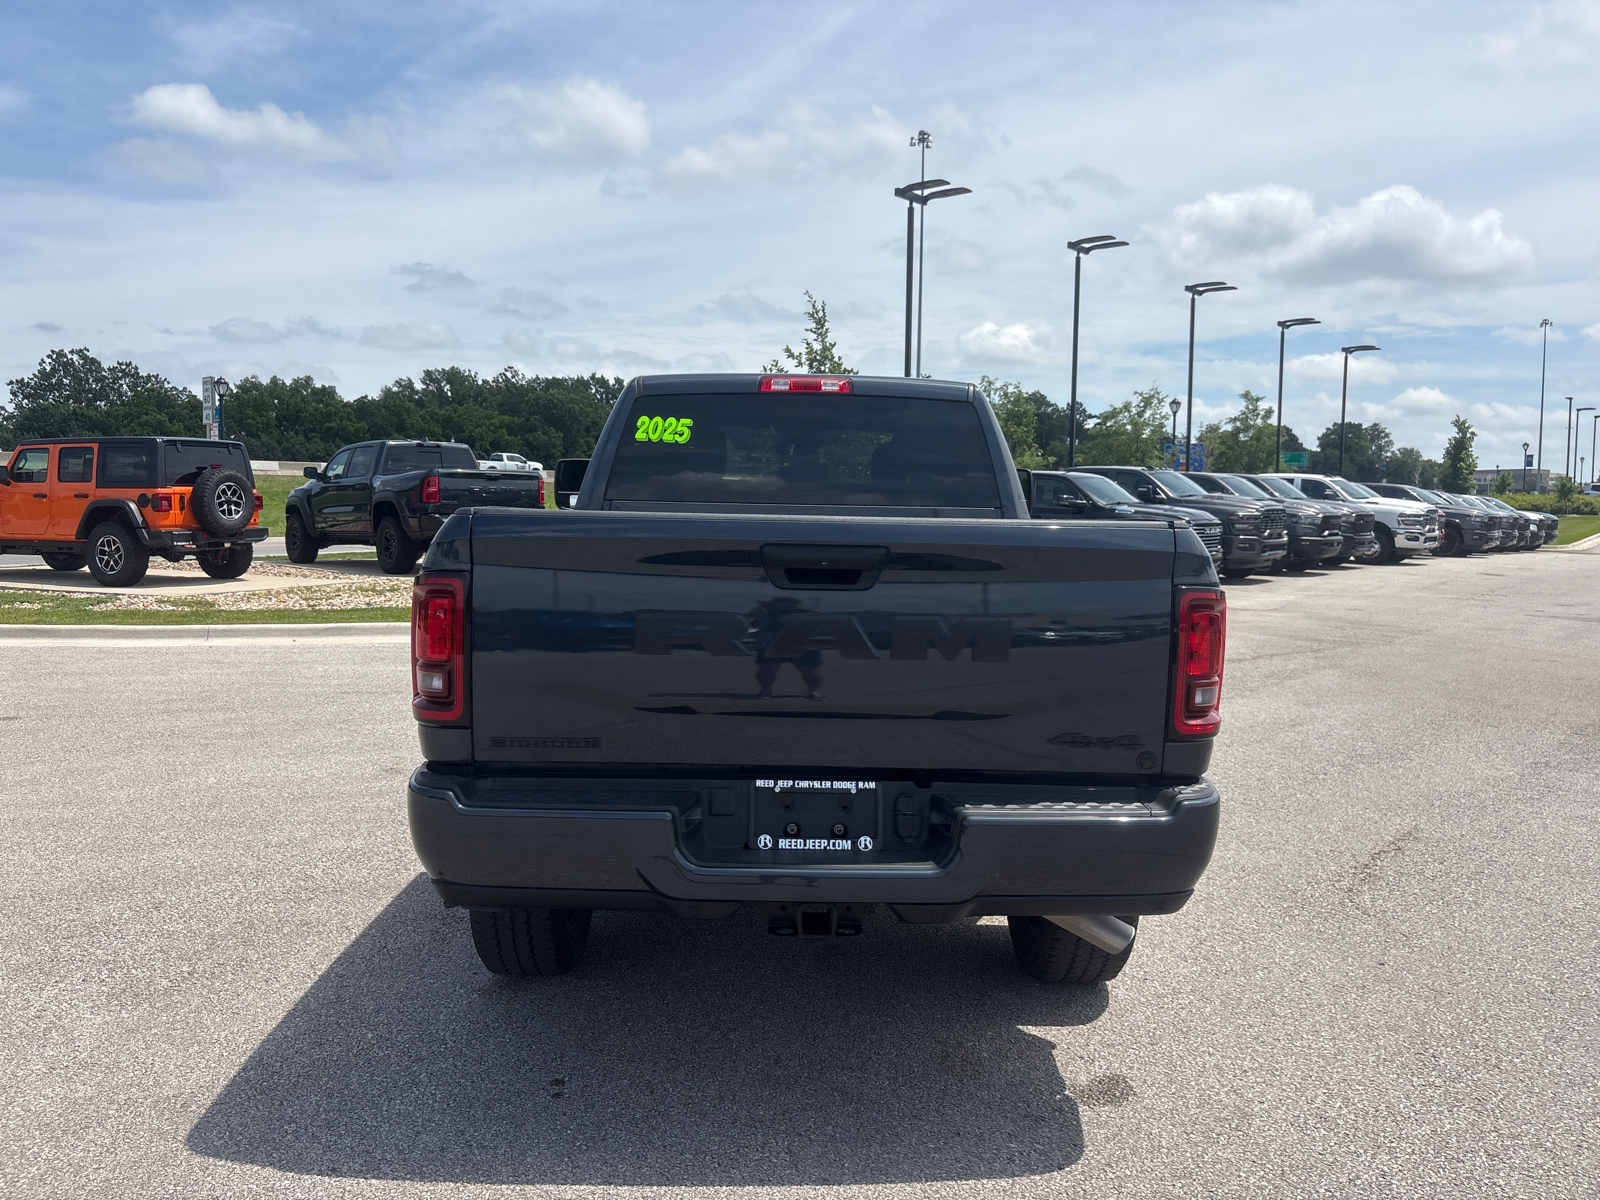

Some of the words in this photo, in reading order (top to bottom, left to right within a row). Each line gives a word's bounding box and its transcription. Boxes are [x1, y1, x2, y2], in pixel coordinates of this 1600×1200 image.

[203, 395, 211, 404] 60
[204, 413, 211, 421] 40
[635, 415, 694, 444] 2025
[469, 485, 515, 494] RAM
[634, 609, 1011, 661] RAM
[755, 779, 774, 788] REED
[776, 780, 793, 788] JEEP
[794, 780, 832, 789] CHRYSLER
[833, 781, 857, 789] DODGE
[858, 781, 876, 789] RAM
[778, 838, 852, 850] REEDJEEP.COM
